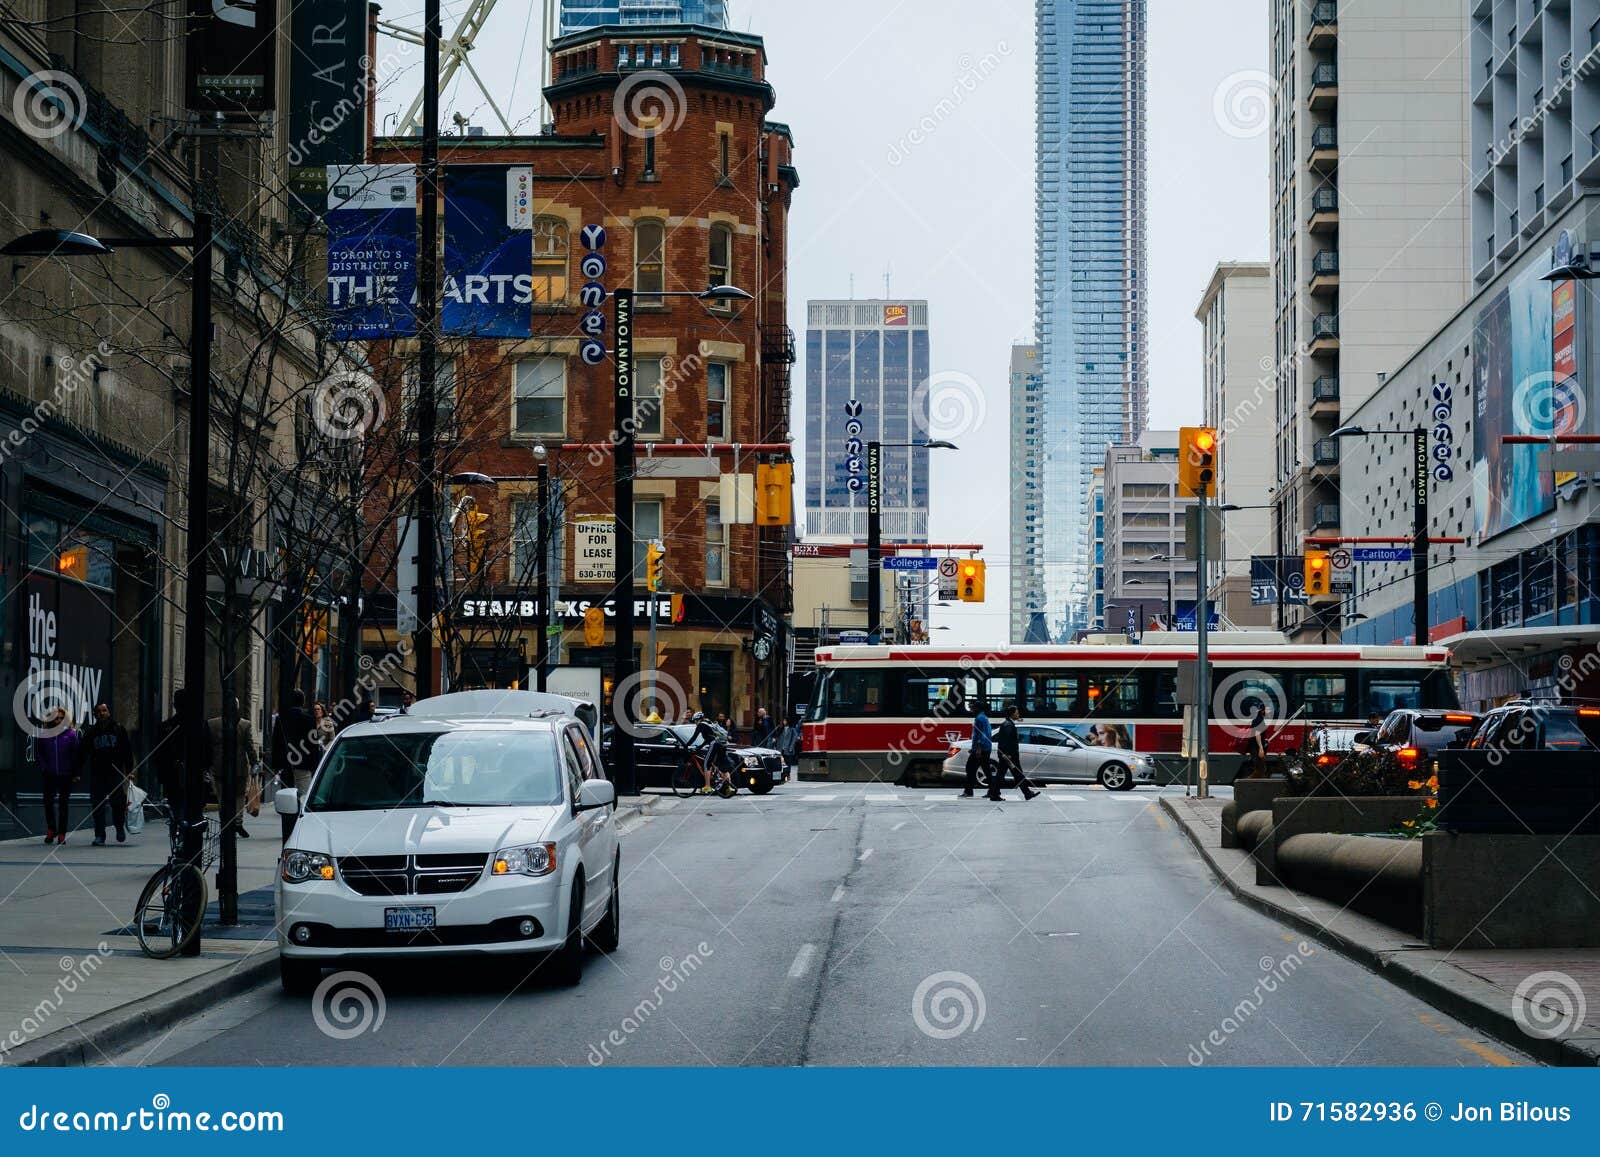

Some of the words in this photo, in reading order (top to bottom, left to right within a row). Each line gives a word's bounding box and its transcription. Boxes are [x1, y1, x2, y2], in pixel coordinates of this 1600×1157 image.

[332, 261, 389, 271] DISTRICT
[395, 261, 410, 270] OF
[328, 275, 399, 305] THE
[442, 274, 533, 304] ARTS
[581, 225, 605, 365] Yonge
[886, 306, 906, 315] CIBC
[618, 297, 629, 398] DOWNTOWN
[845, 400, 863, 492] Yonge
[1432, 382, 1452, 482] Yonge
[870, 448, 878, 514] DOWNTOWN
[1418, 435, 1426, 505] DOWNTOWN
[583, 548, 612, 558] LEASE
[588, 535, 607, 545] FOR
[1361, 549, 1397, 560] Carlton
[890, 559, 924, 570] College
[29, 592, 57, 657] the
[1177, 622, 1193, 630] THE
